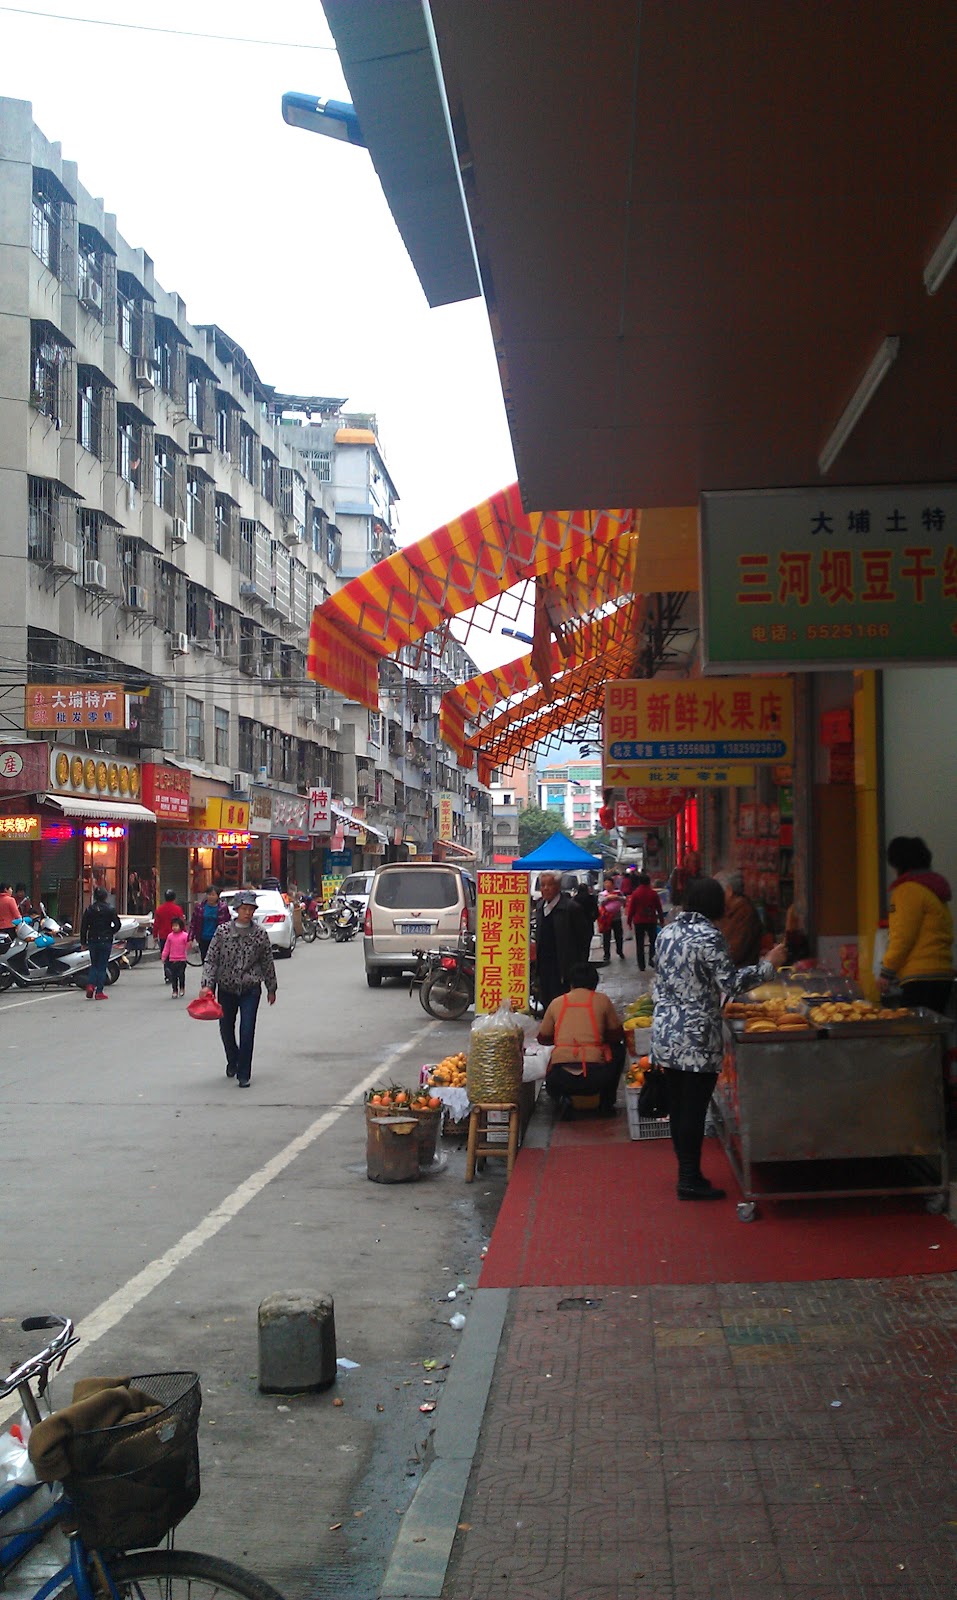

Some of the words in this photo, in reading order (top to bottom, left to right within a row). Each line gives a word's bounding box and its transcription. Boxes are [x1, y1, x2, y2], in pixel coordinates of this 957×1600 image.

[51, 690, 117, 708] 大埔特产
[610, 687, 638, 739] 明明
[646, 690, 784, 733] 新鲜水果店
[311, 790, 328, 829] 特产
[480, 873, 528, 894] 特记正宗
[480, 898, 503, 1012] 刷酱千层饼
[508, 898, 526, 1011] 南京小笼灌汤包
